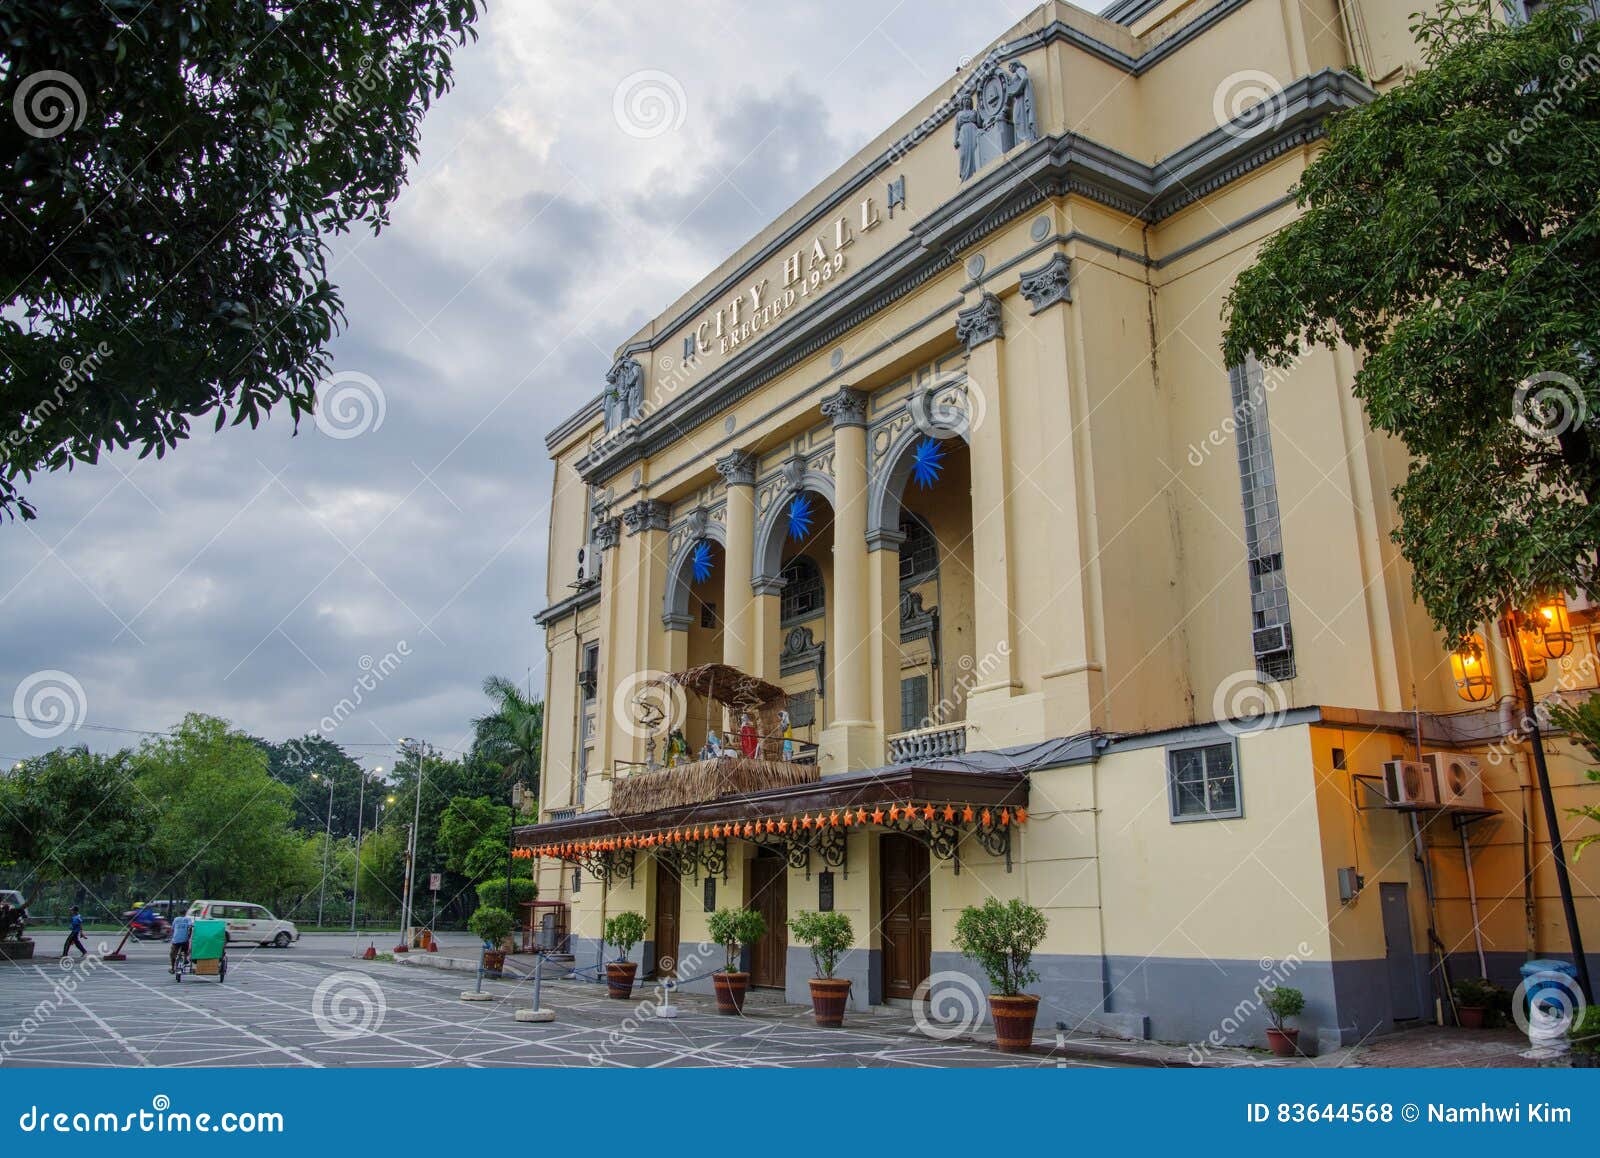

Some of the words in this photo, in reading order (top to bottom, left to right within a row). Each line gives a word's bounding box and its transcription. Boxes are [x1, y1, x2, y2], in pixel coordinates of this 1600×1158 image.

[695, 279, 768, 353] CITY
[782, 197, 881, 289] HALL
[720, 289, 796, 355] ERECTED
[801, 252, 845, 297] 1939
